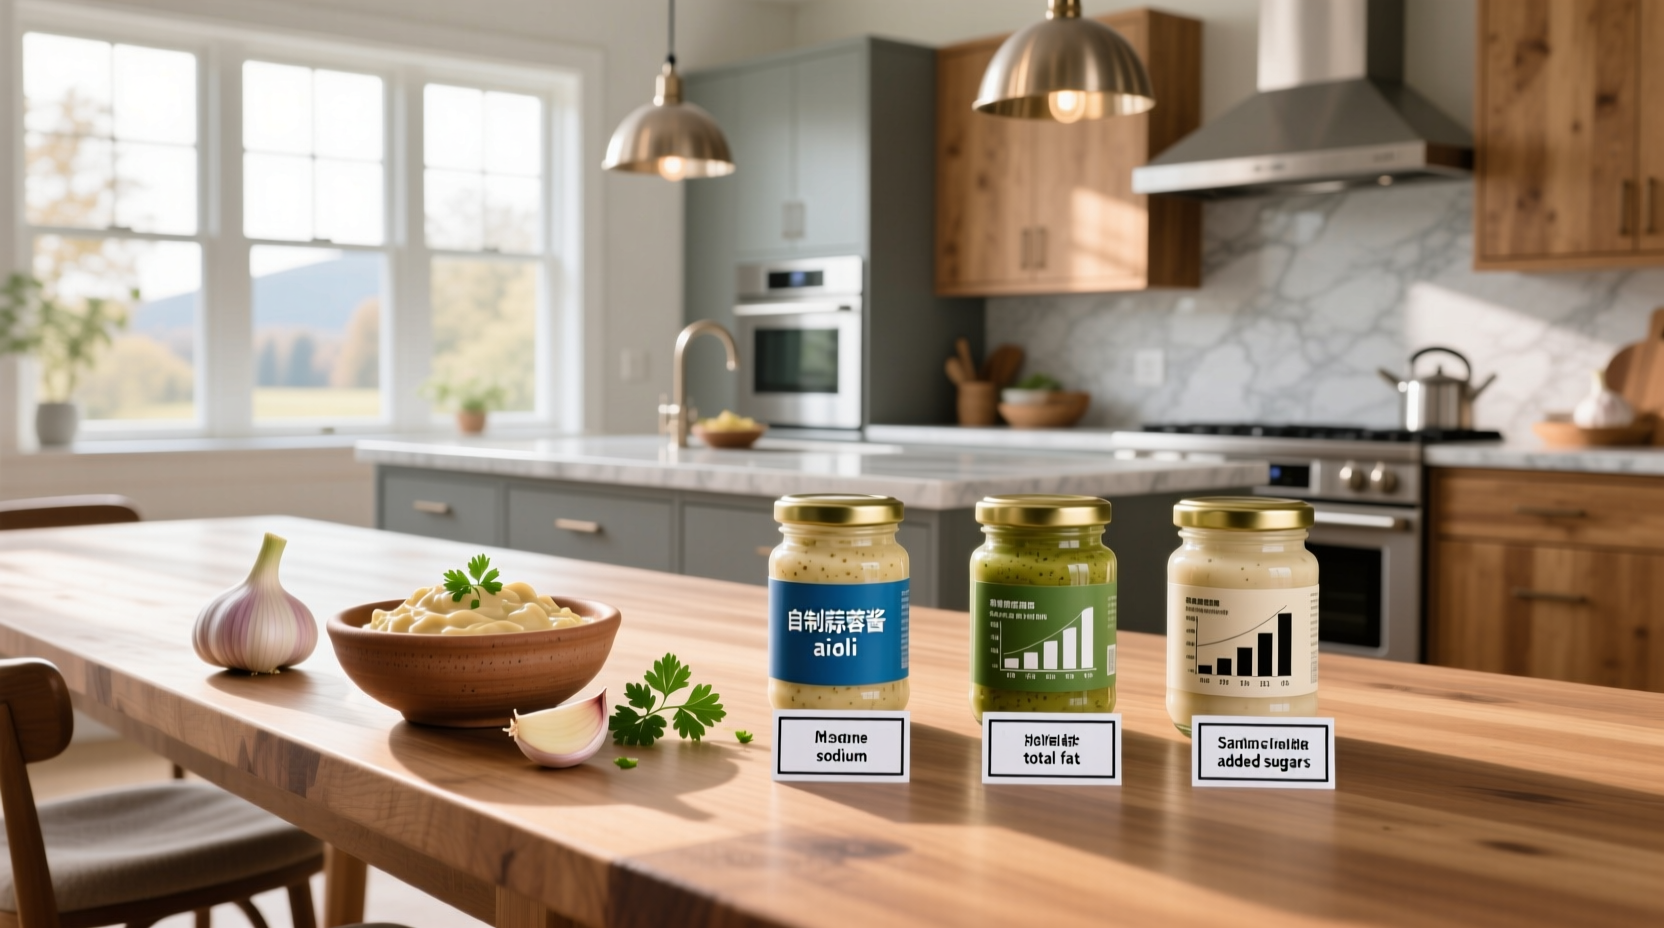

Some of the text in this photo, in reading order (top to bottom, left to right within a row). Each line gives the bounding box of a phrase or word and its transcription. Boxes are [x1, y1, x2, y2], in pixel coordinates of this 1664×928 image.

[813, 637, 857, 657] aioli
[816, 748, 868, 763] sodium
[1023, 750, 1081, 765] total fat
[1217, 753, 1311, 772] added sugars
